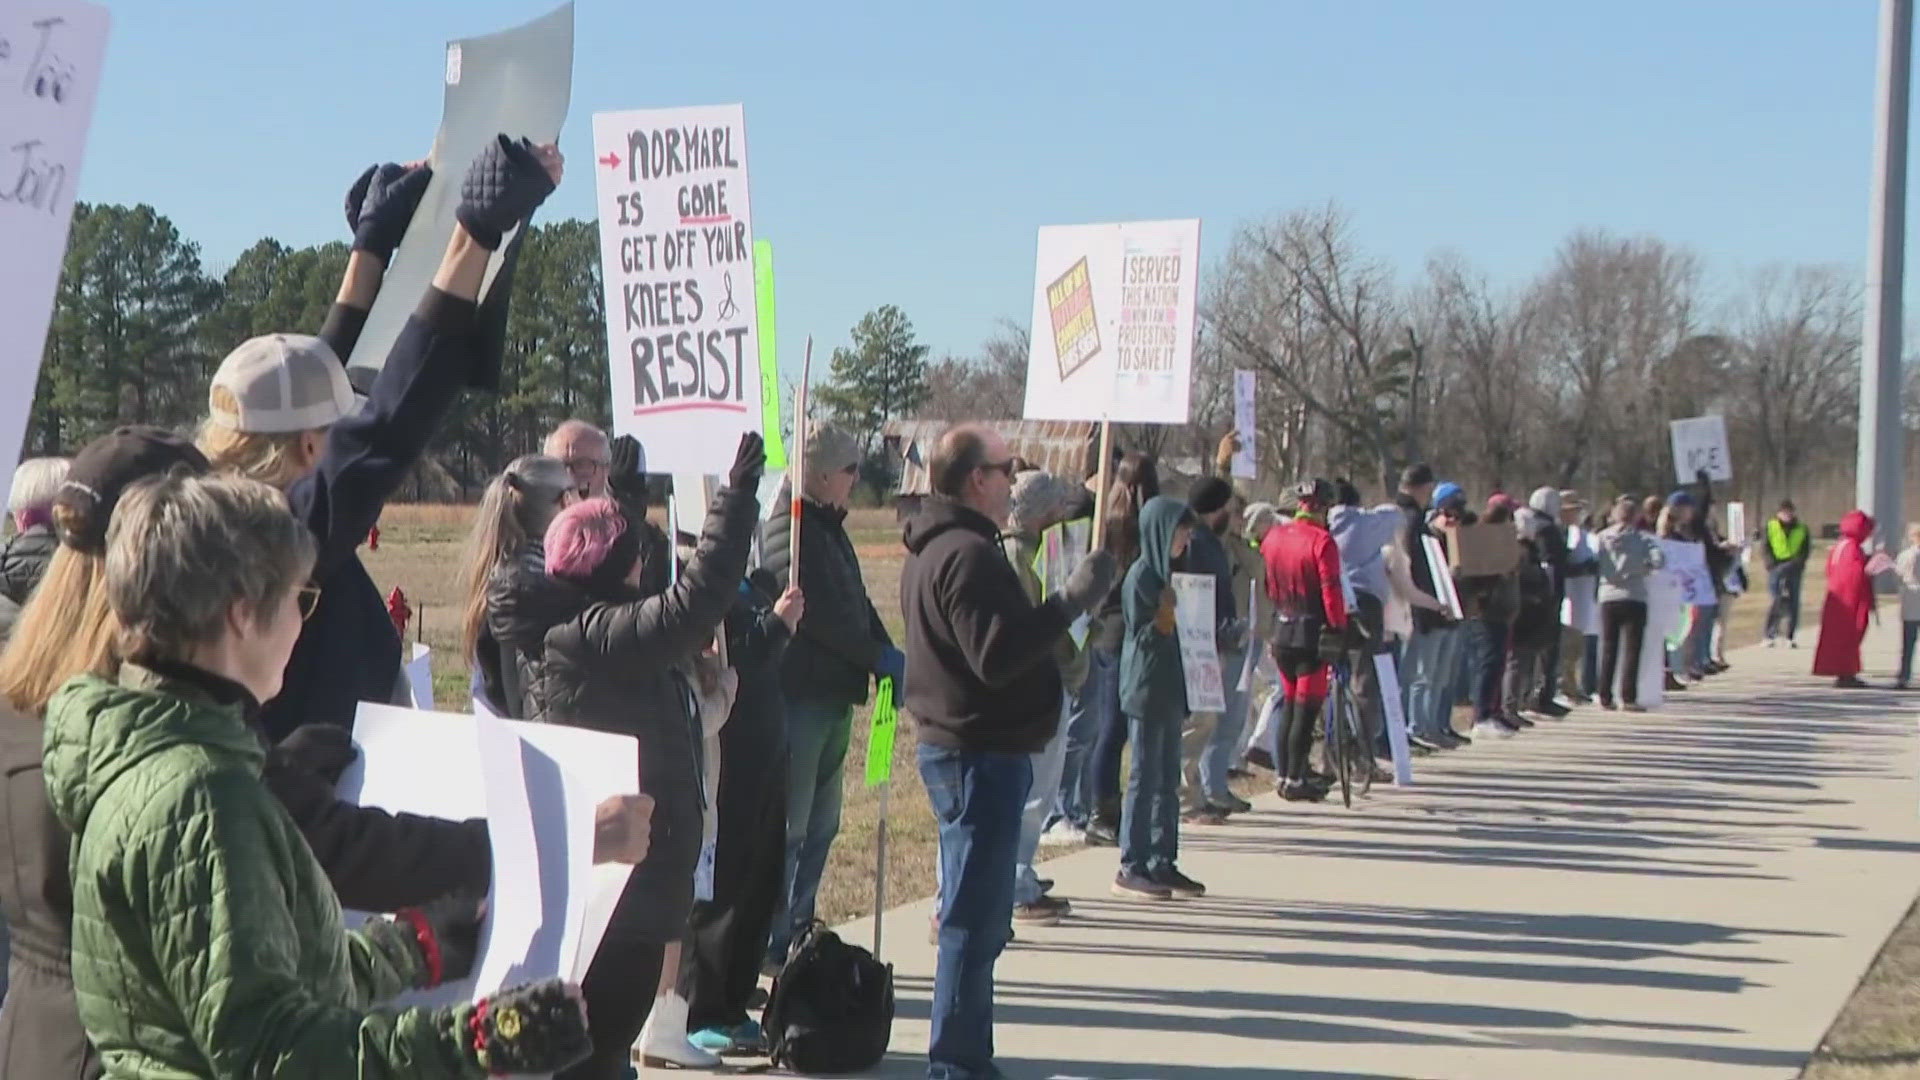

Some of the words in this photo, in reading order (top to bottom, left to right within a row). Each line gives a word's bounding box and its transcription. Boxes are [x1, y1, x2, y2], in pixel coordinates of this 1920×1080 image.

[617, 194, 644, 226] IS
[678, 180, 728, 218] GONE
[621, 234, 657, 274] GET
[664, 228, 697, 272] OFF
[702, 221, 748, 267] YOUR
[1122, 256, 1128, 284] I
[1130, 255, 1181, 284] SERVED
[623, 279, 703, 333] KNEES
[717, 270, 741, 322] &
[1121, 286, 1142, 307] THIS
[1144, 285, 1179, 307] NATION
[1118, 324, 1177, 346] PROTESTING
[631, 326, 749, 407] RESIST
[1118, 346, 1131, 371] TO
[1133, 346, 1161, 371] SAVE
[1163, 346, 1176, 371] IT
